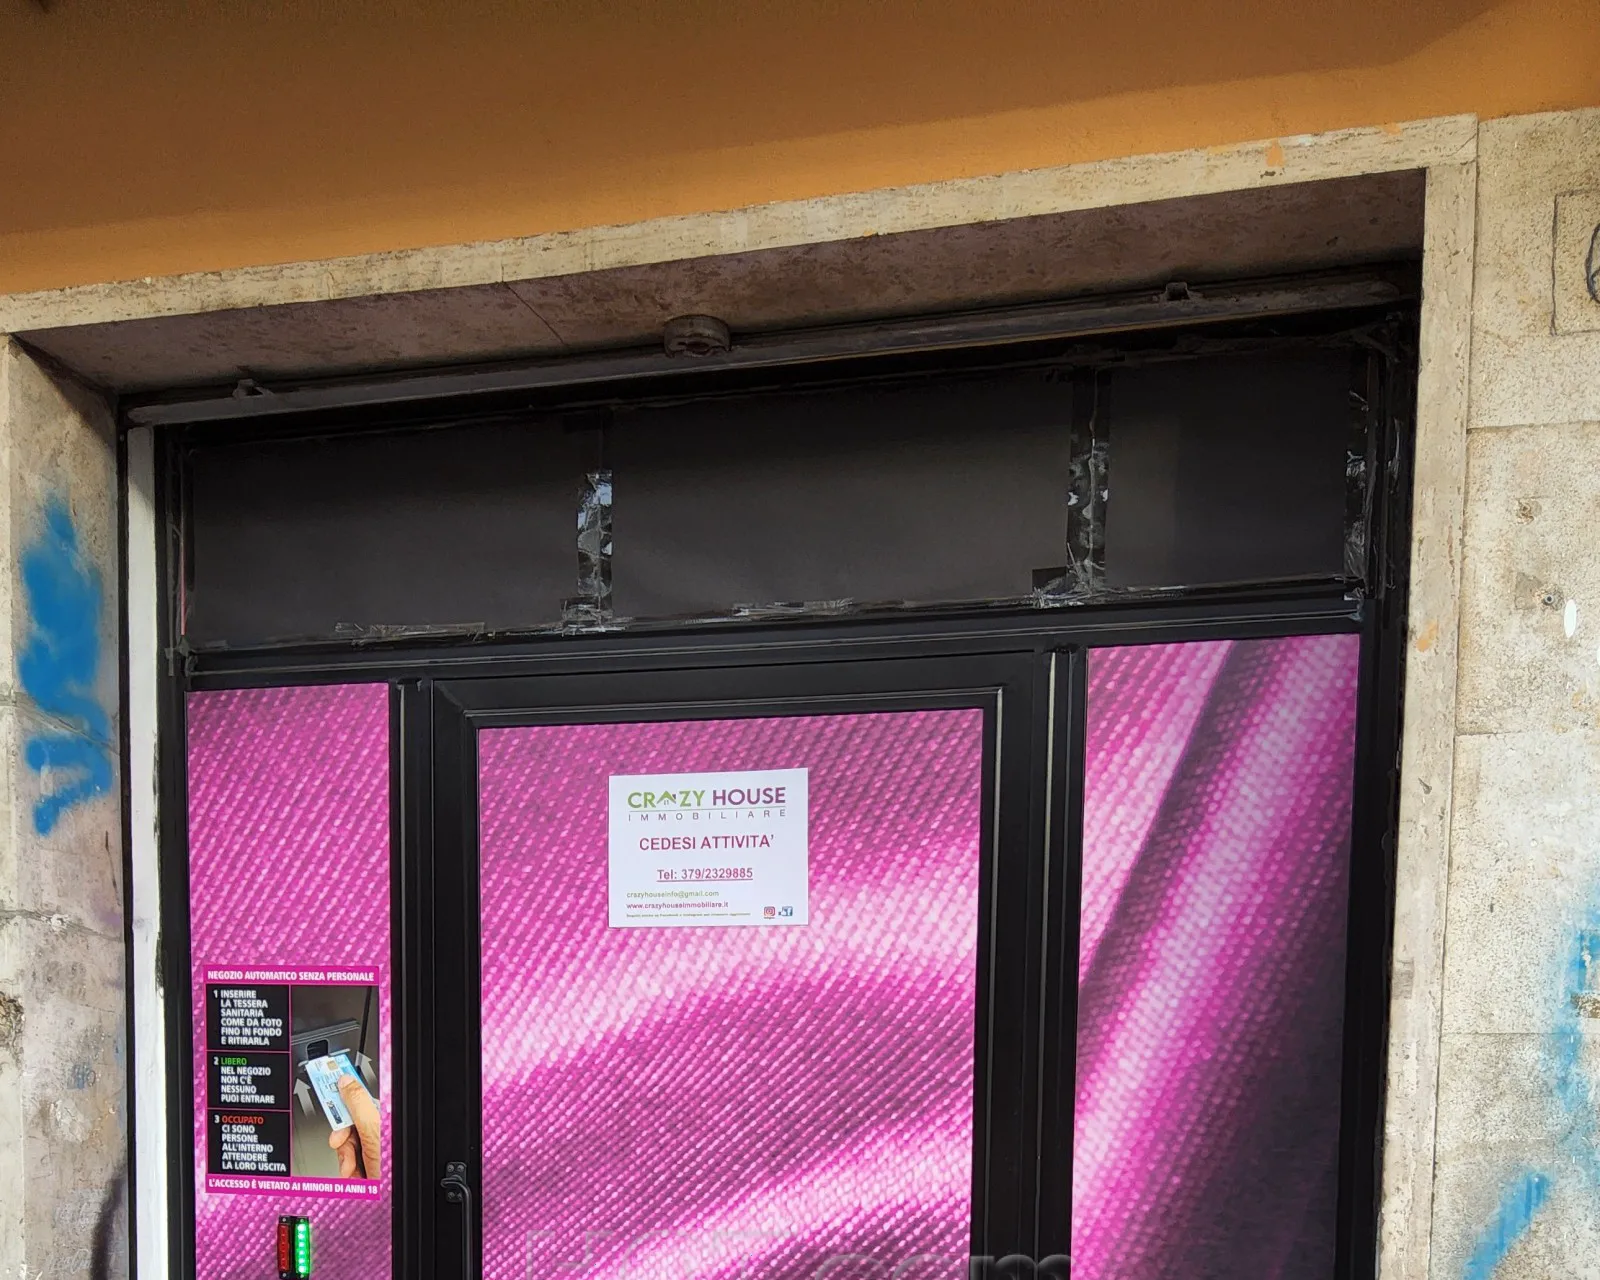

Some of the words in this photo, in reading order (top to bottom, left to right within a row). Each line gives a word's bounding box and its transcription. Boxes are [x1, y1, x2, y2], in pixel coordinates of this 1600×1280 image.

[628, 790, 705, 809] CRAZY
[713, 786, 786, 806] HOUSE
[628, 809, 786, 822] IMMOBILIARE
[639, 836, 696, 850] CEDESI
[657, 869, 677, 880] Tel:
[681, 868, 753, 880] 379/2329885
[626, 890, 719, 899] crazyhouseinfo@gmail.com
[626, 902, 729, 910] www.crazyhouseimmobiliare.it
[208, 971, 242, 980] NEGOZIO
[245, 971, 297, 981] AUTOMATICO
[299, 972, 325, 981] SENZA
[327, 972, 374, 982] PERSONALE
[214, 990, 218, 998] 1
[221, 990, 256, 998] INSERIRE
[221, 999, 231, 1008] LA
[232, 999, 268, 1008] TESSERA
[221, 1008, 264, 1017] SANITARIA
[221, 1018, 245, 1026] COME
[247, 1018, 259, 1027] DA
[261, 1018, 282, 1027] FOTO
[221, 1027, 240, 1036] FINO
[242, 1027, 251, 1036] IN
[253, 1028, 282, 1037] FONDO
[221, 1036, 226, 1045] E
[228, 1036, 269, 1046] RITIRARLA
[214, 1057, 219, 1065] 2
[221, 1057, 247, 1066] LIBERO
[221, 1066, 235, 1075] NEL
[237, 1067, 271, 1076] NEGOZIO
[221, 1075, 238, 1084] NON
[221, 1085, 256, 1094] NESSUNO
[221, 1094, 239, 1103] PUOI
[241, 1095, 275, 1104] ENTRARE
[214, 1115, 220, 1123] 3
[222, 1115, 264, 1125] OCCUPATO
[222, 1125, 230, 1133] CI
[232, 1125, 255, 1134] SONO
[222, 1134, 258, 1143] PERSONE
[222, 1143, 273, 1153] ALL'INTERNO
[222, 1153, 267, 1162] ATTENDERE
[222, 1162, 233, 1170] LA
[235, 1162, 256, 1171] LORO
[258, 1162, 286, 1172] USCITA
[209, 1179, 250, 1189] L'ACCESSO
[252, 1178, 256, 1189] È
[258, 1180, 290, 1190] VIETATO
[292, 1182, 300, 1191] AI
[302, 1182, 333, 1192] MINORI
[335, 1184, 343, 1192] DI
[345, 1184, 365, 1193] ANNI
[367, 1185, 378, 1194] 18
